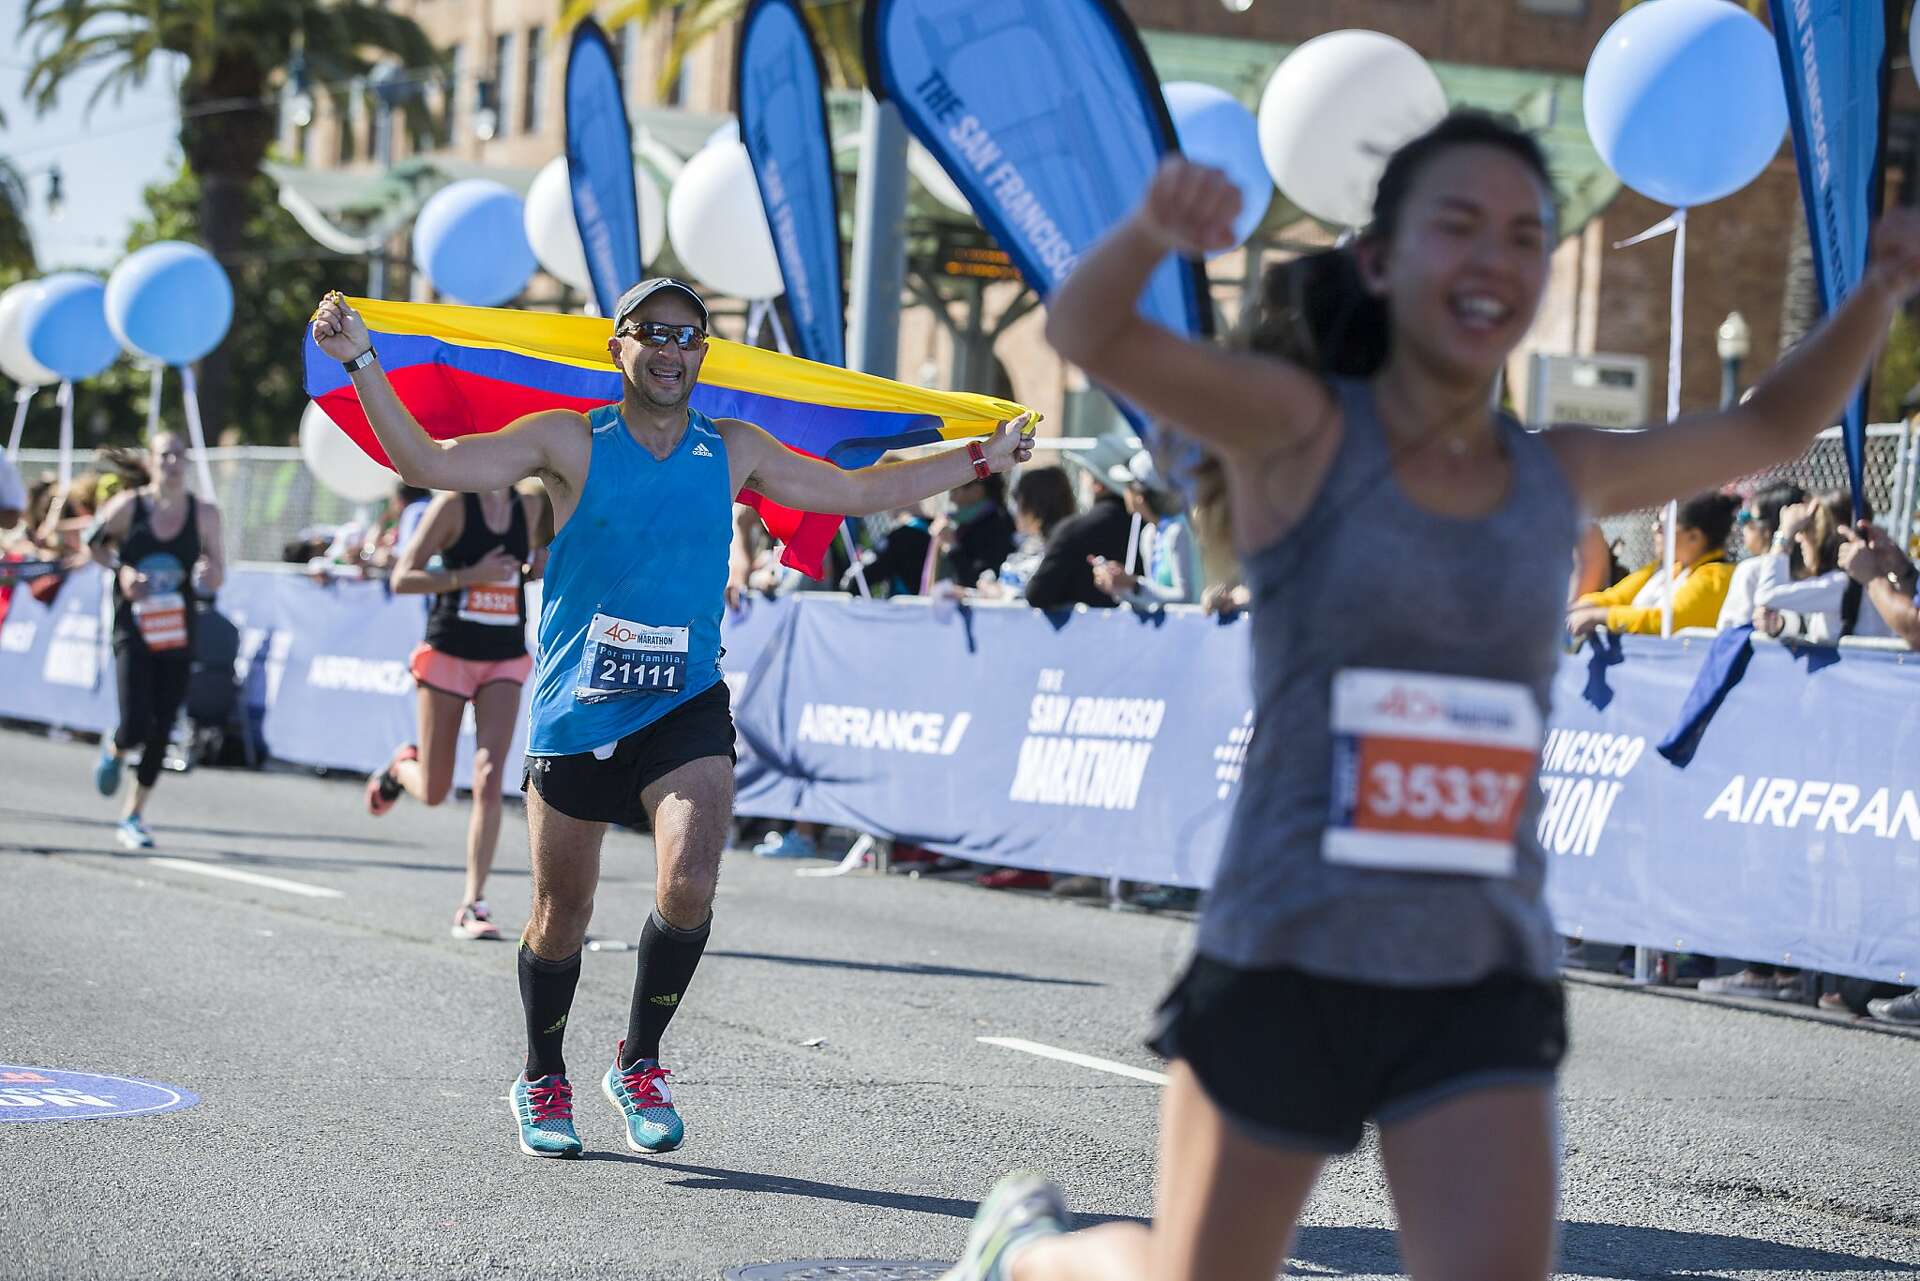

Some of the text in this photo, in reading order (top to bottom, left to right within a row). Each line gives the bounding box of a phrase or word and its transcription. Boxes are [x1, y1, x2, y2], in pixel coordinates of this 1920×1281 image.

[915, 69, 965, 122] THE
[949, 115, 1001, 173] SAN
[600, 646, 617, 657] Por
[622, 652, 635, 660] mi
[637, 635, 673, 645] MARATHON
[599, 659, 675, 687] 21111
[797, 702, 945, 755] AIRFRANCE
[1027, 693, 1166, 739] SAN FRANCISCO
[1009, 734, 1153, 810] MARATHON
[1704, 774, 1920, 842] AIRFRAN
